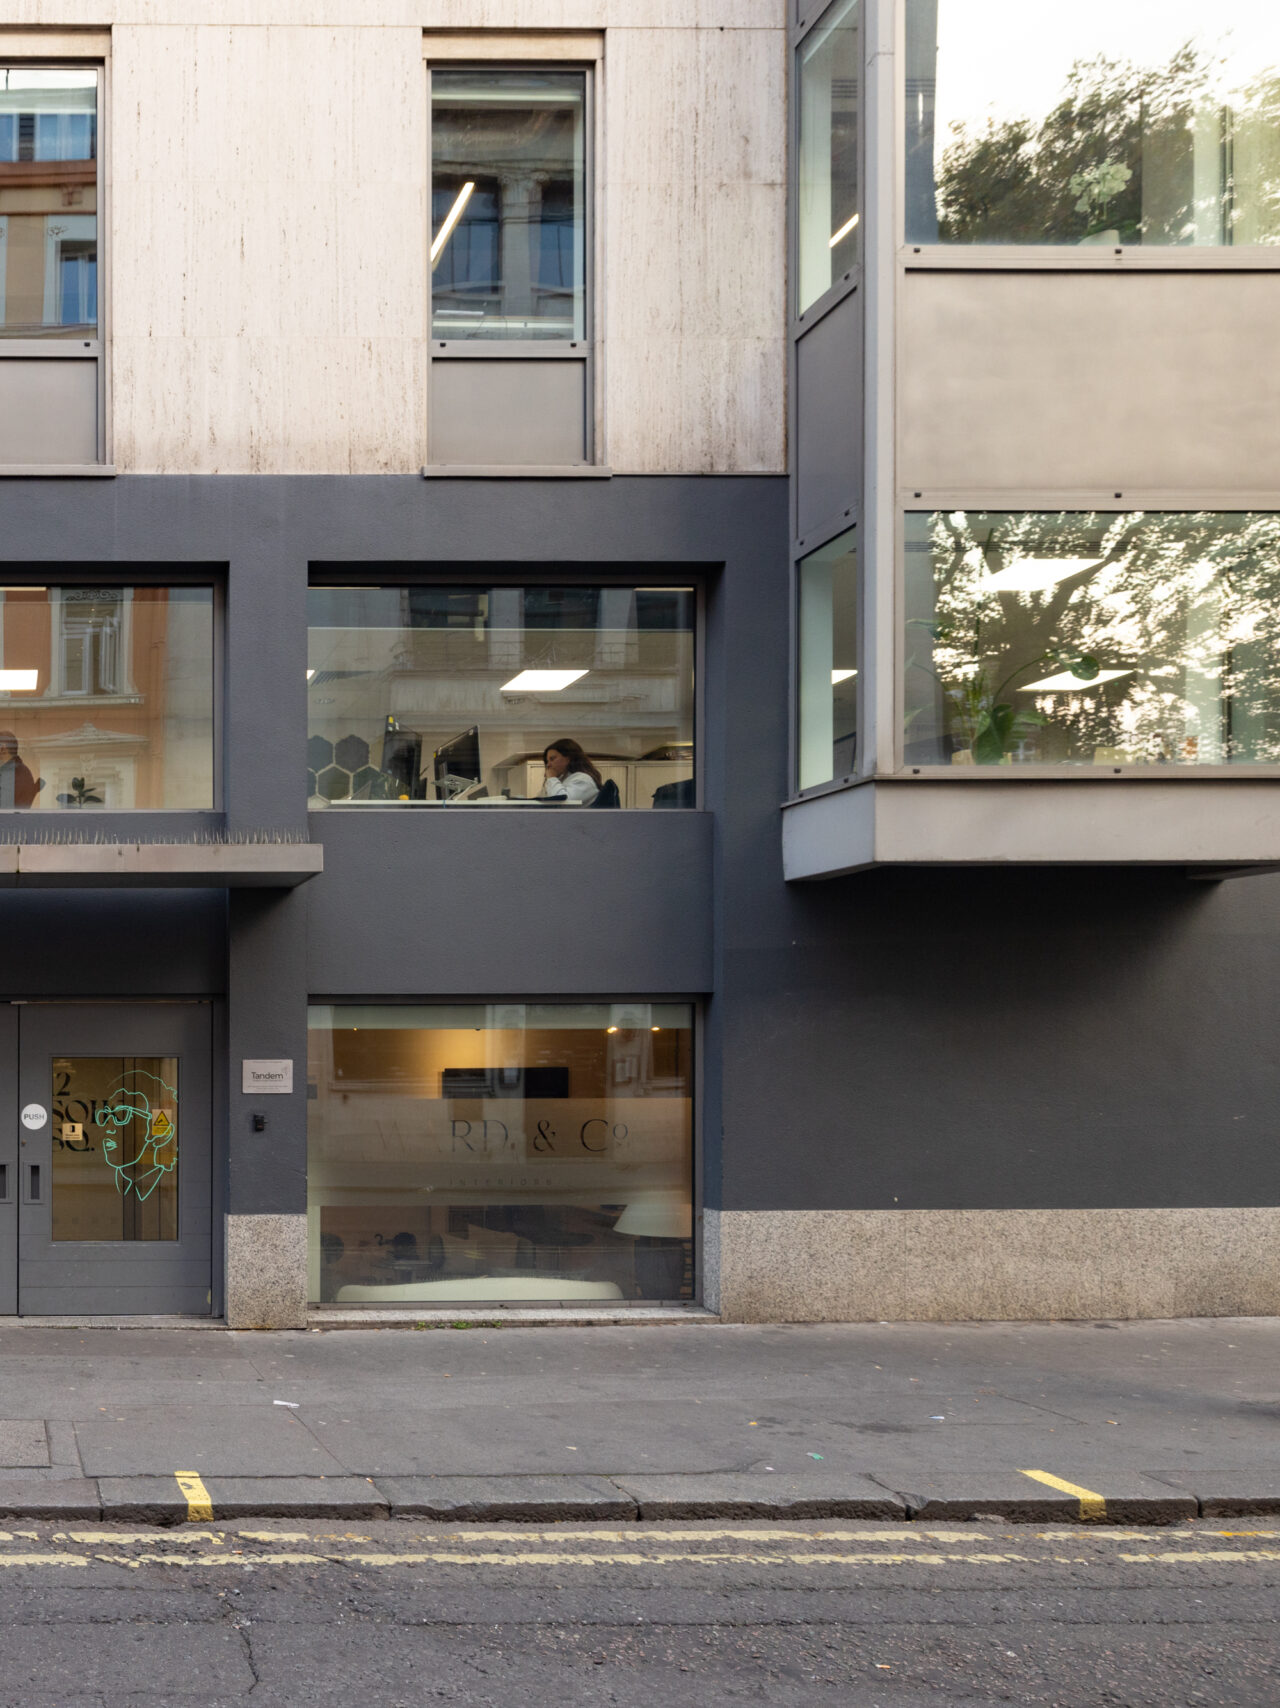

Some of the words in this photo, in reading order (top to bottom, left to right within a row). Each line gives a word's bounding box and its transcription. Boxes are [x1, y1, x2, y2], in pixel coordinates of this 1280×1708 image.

[53, 1072, 71, 1097] 2
[251, 1071, 284, 1080] Tandem
[376, 1119, 509, 1152] WRD
[533, 1119, 556, 1152] &
